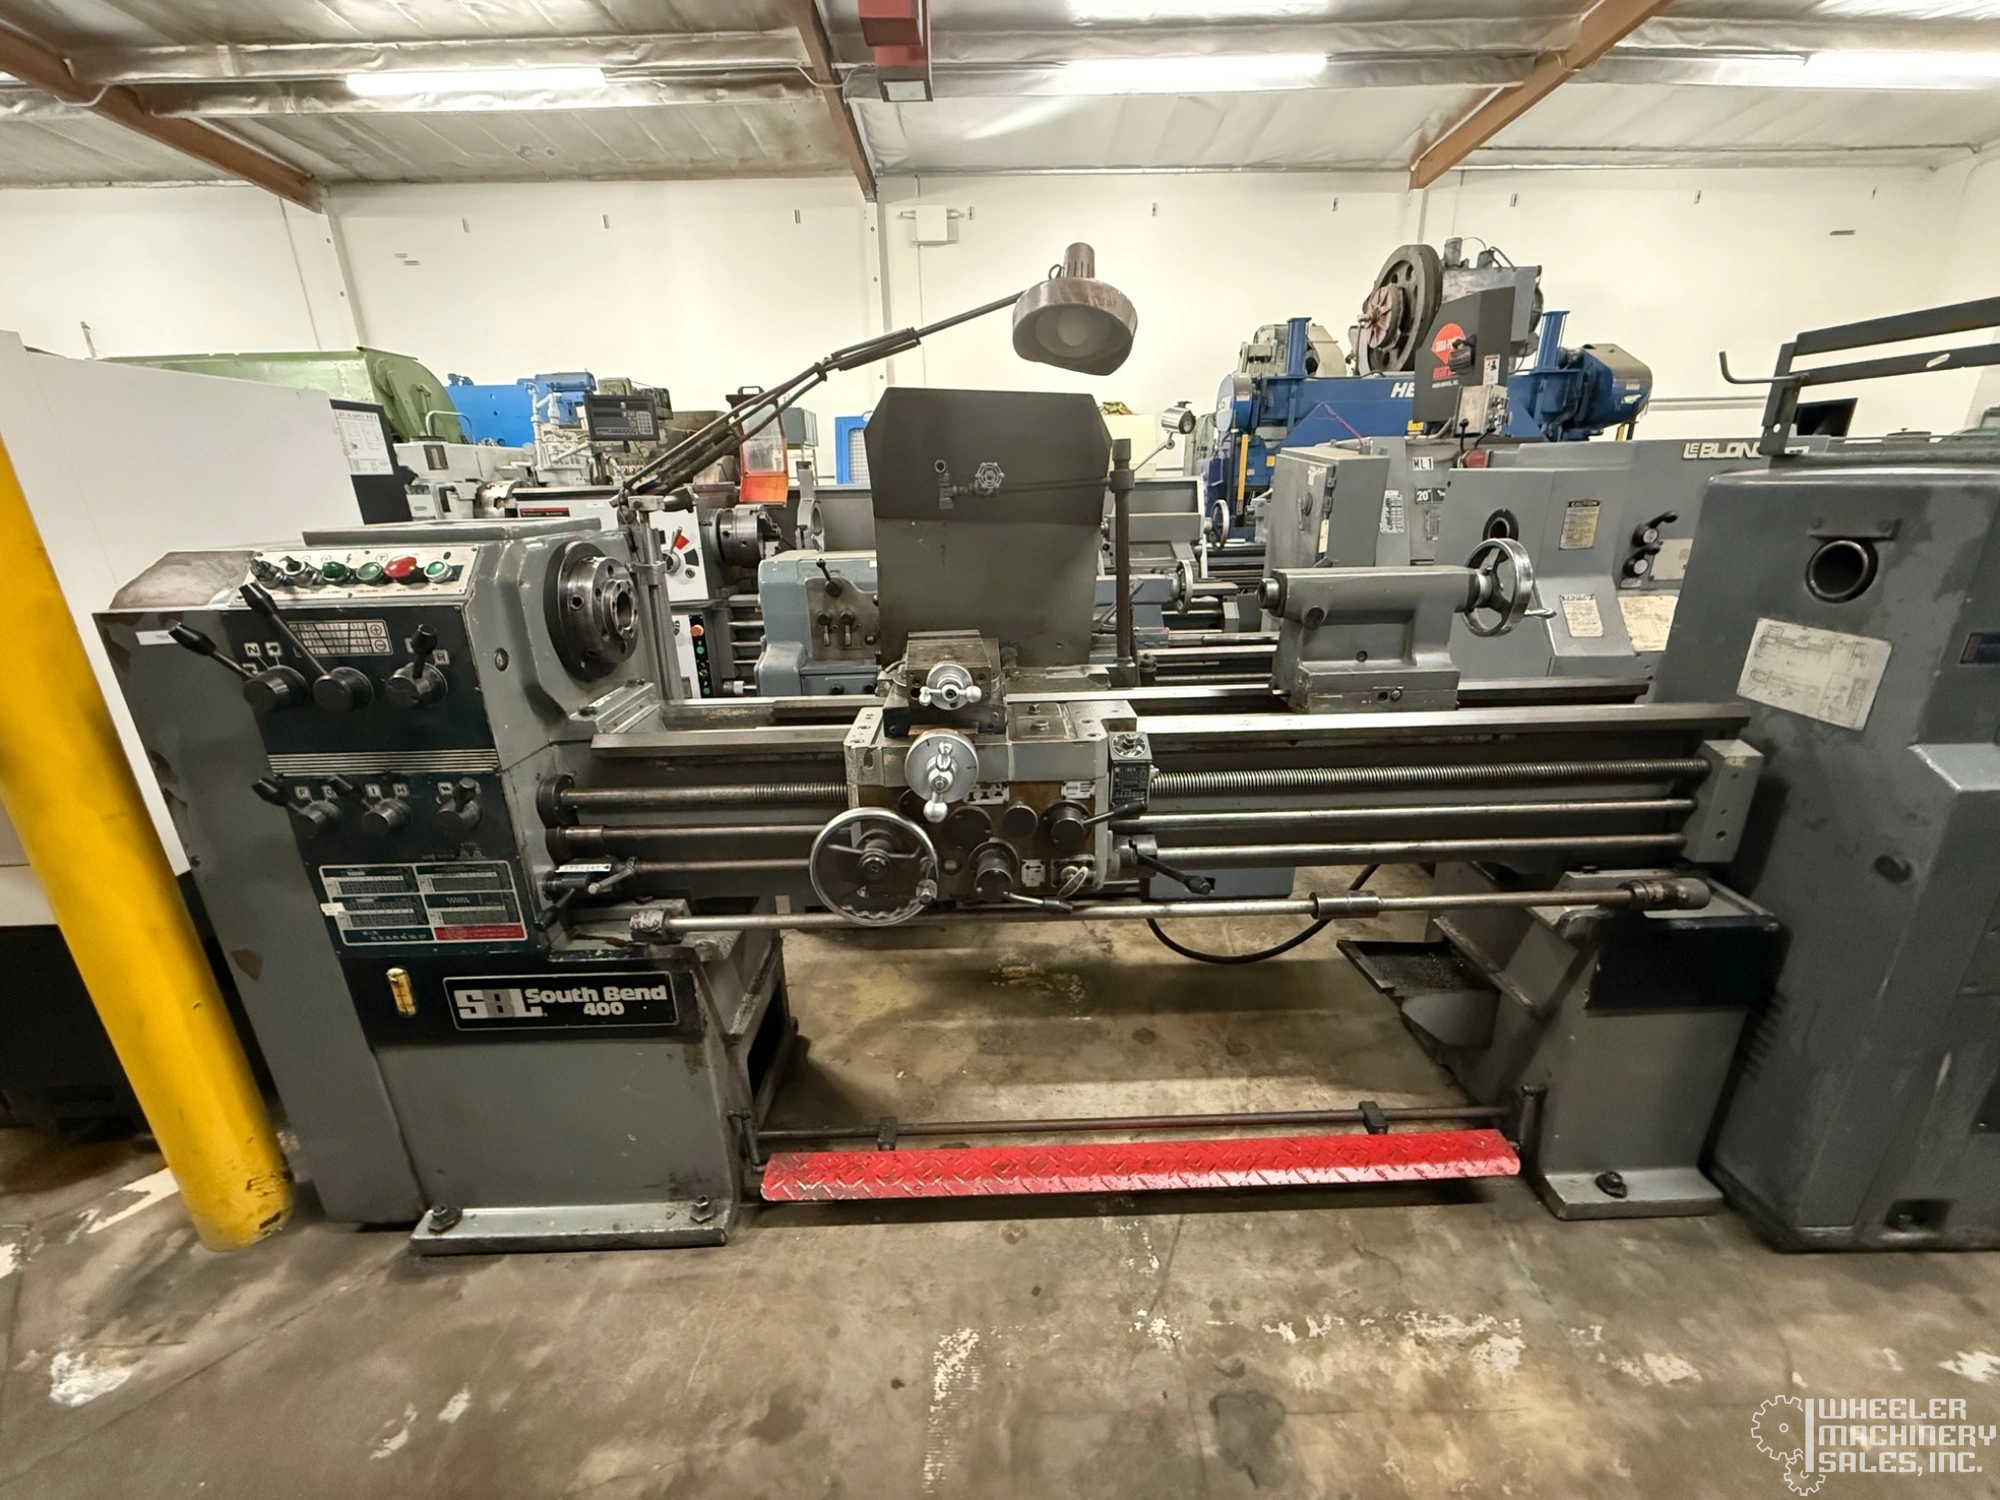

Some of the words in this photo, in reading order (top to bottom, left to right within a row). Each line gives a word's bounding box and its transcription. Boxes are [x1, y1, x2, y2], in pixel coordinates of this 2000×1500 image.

[525, 986, 598, 1004] South
[603, 985, 668, 1002] Bend
[583, 1001, 625, 1016] 400
